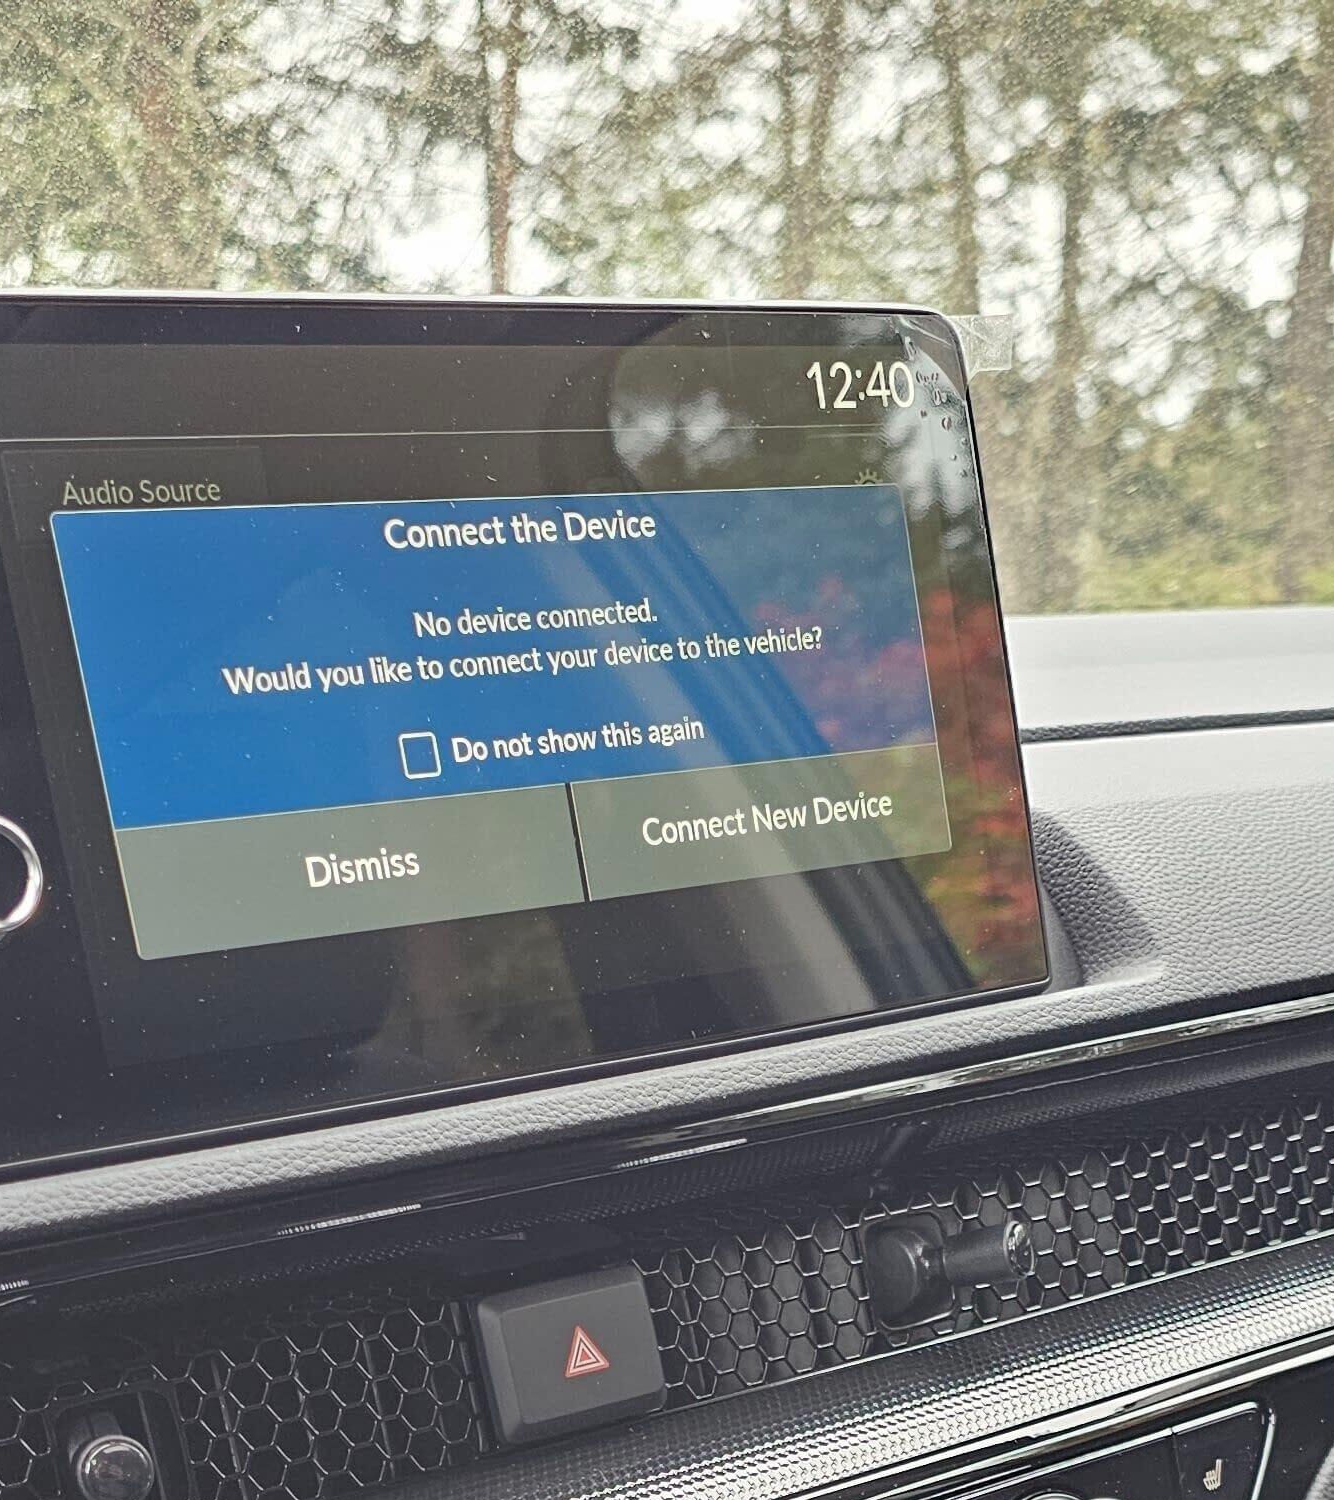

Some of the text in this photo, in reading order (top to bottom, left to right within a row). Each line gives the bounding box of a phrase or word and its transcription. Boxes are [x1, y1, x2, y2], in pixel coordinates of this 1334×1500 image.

[806, 360, 915, 410] 12:40
[62, 478, 221, 506] Audio Source
[383, 509, 656, 550] Connect the Device
[413, 598, 658, 638] No device connected.
[222, 626, 824, 695] Would you like to connect your device to the vehicle?
[452, 718, 706, 763] Do not show this again
[641, 791, 894, 847] Connect New Device
[306, 850, 421, 887] Dismiss
